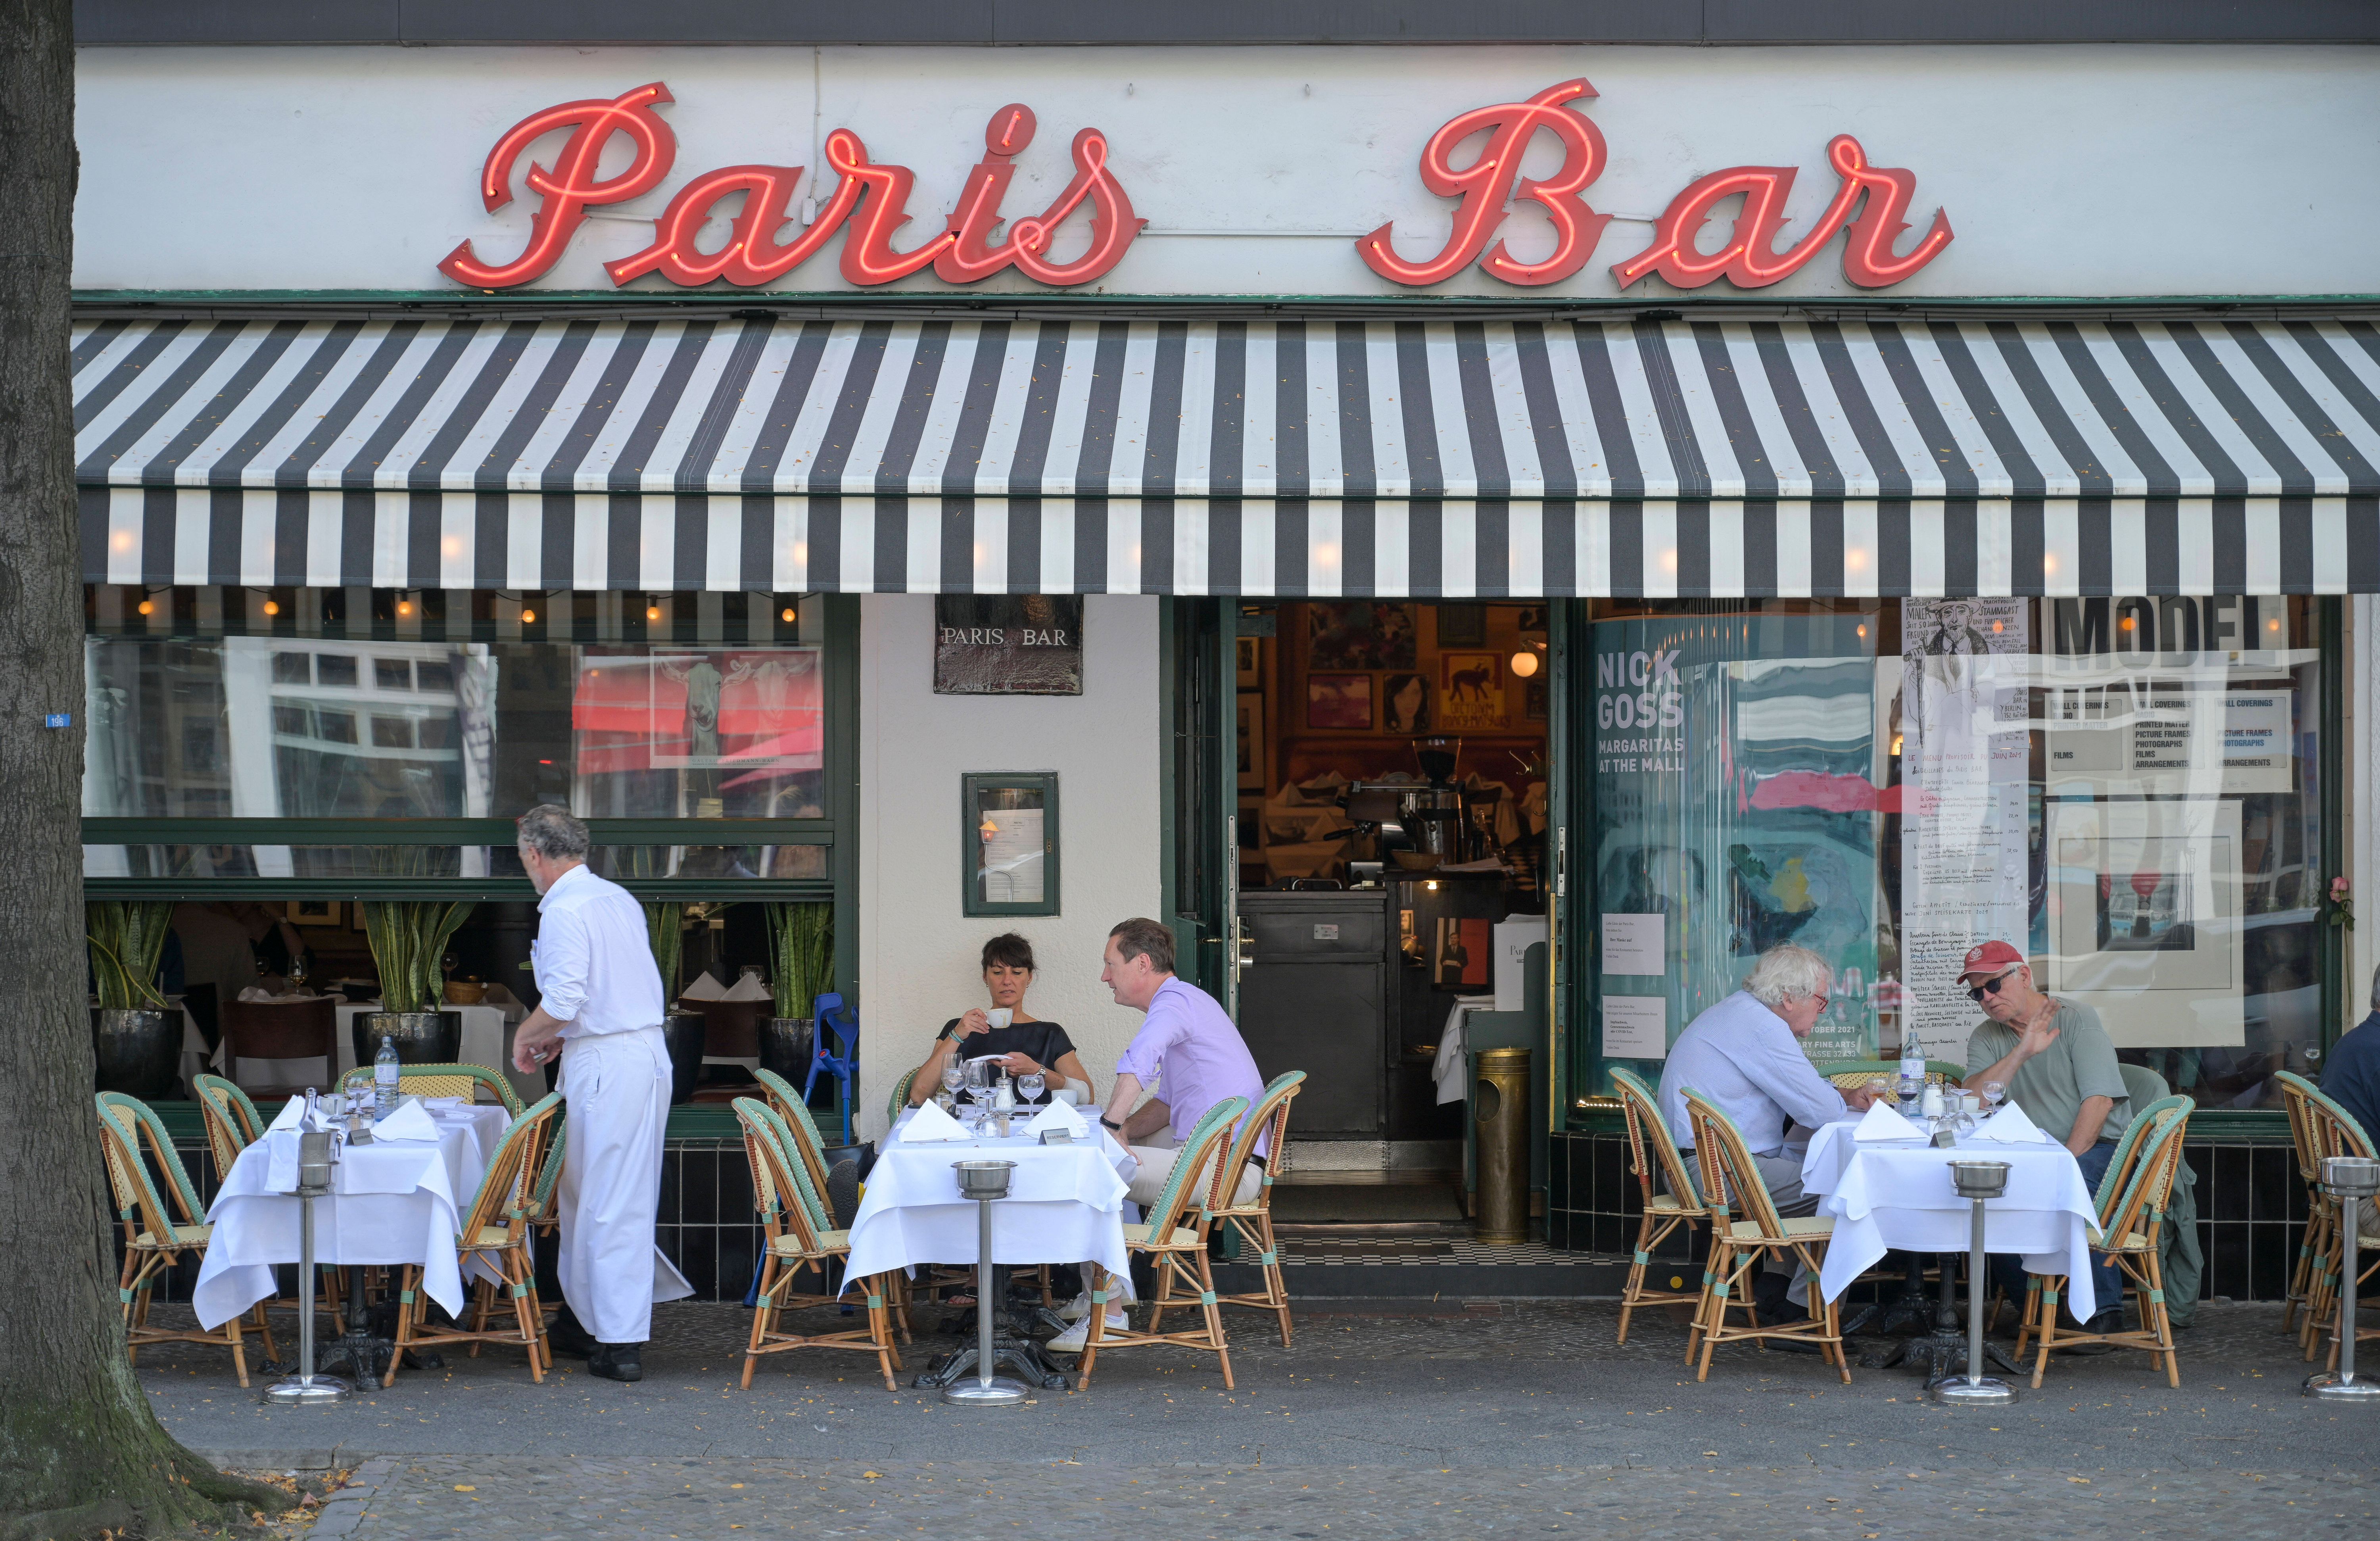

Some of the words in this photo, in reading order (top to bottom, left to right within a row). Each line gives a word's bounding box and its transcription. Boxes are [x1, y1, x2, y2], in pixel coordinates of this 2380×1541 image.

[437, 81, 1150, 287] Paris
[1354, 77, 1955, 291] Bar
[1906, 607, 1931, 620] MALER
[1979, 605, 2019, 616] STAMMGAST
[943, 628, 1004, 645] PARIS
[1022, 629, 1068, 646] BAR
[1907, 630, 1929, 639] FREUND
[1598, 650, 1682, 688] NICK
[1598, 692, 1683, 730] GOSS
[51, 718, 63, 726] 196
[1599, 738, 1684, 754] MARGARITAS
[1991, 750, 2007, 759] JUIN
[1599, 759, 1610, 773] AT
[1613, 758, 1637, 772] THE
[1642, 757, 1684, 772] MALL
